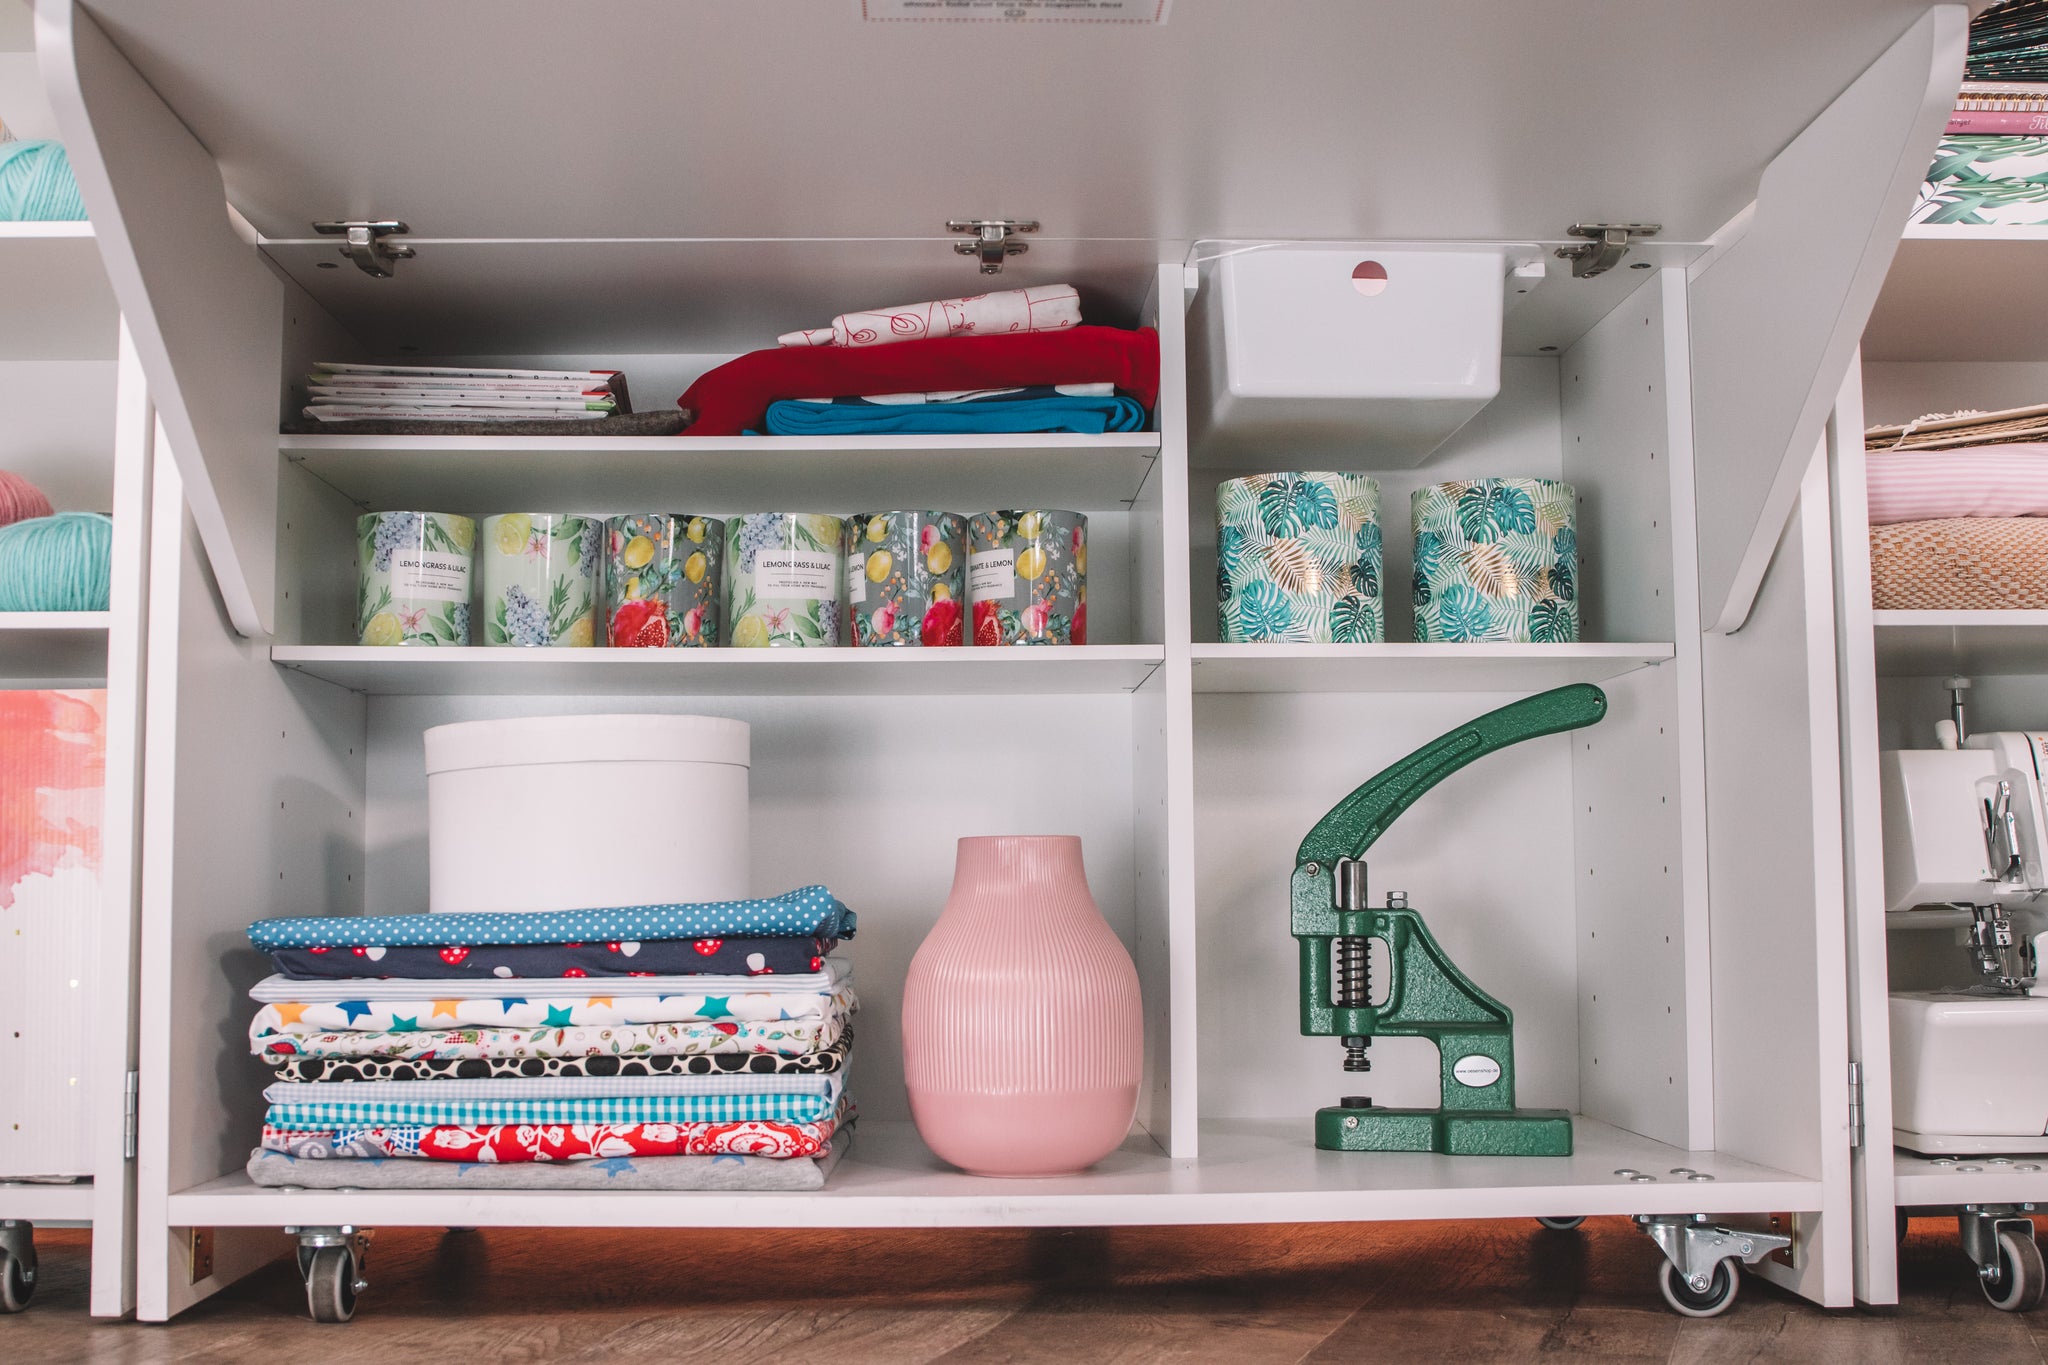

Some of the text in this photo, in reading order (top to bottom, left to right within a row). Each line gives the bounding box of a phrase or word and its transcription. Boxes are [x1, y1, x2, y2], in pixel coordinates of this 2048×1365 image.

[399, 560, 466, 573] LEMONGRASS & LILAC
[810, 562, 815, 570] &
[815, 562, 831, 571] LILAC
[985, 561, 990, 569] &
[990, 560, 1013, 568] LEMON
